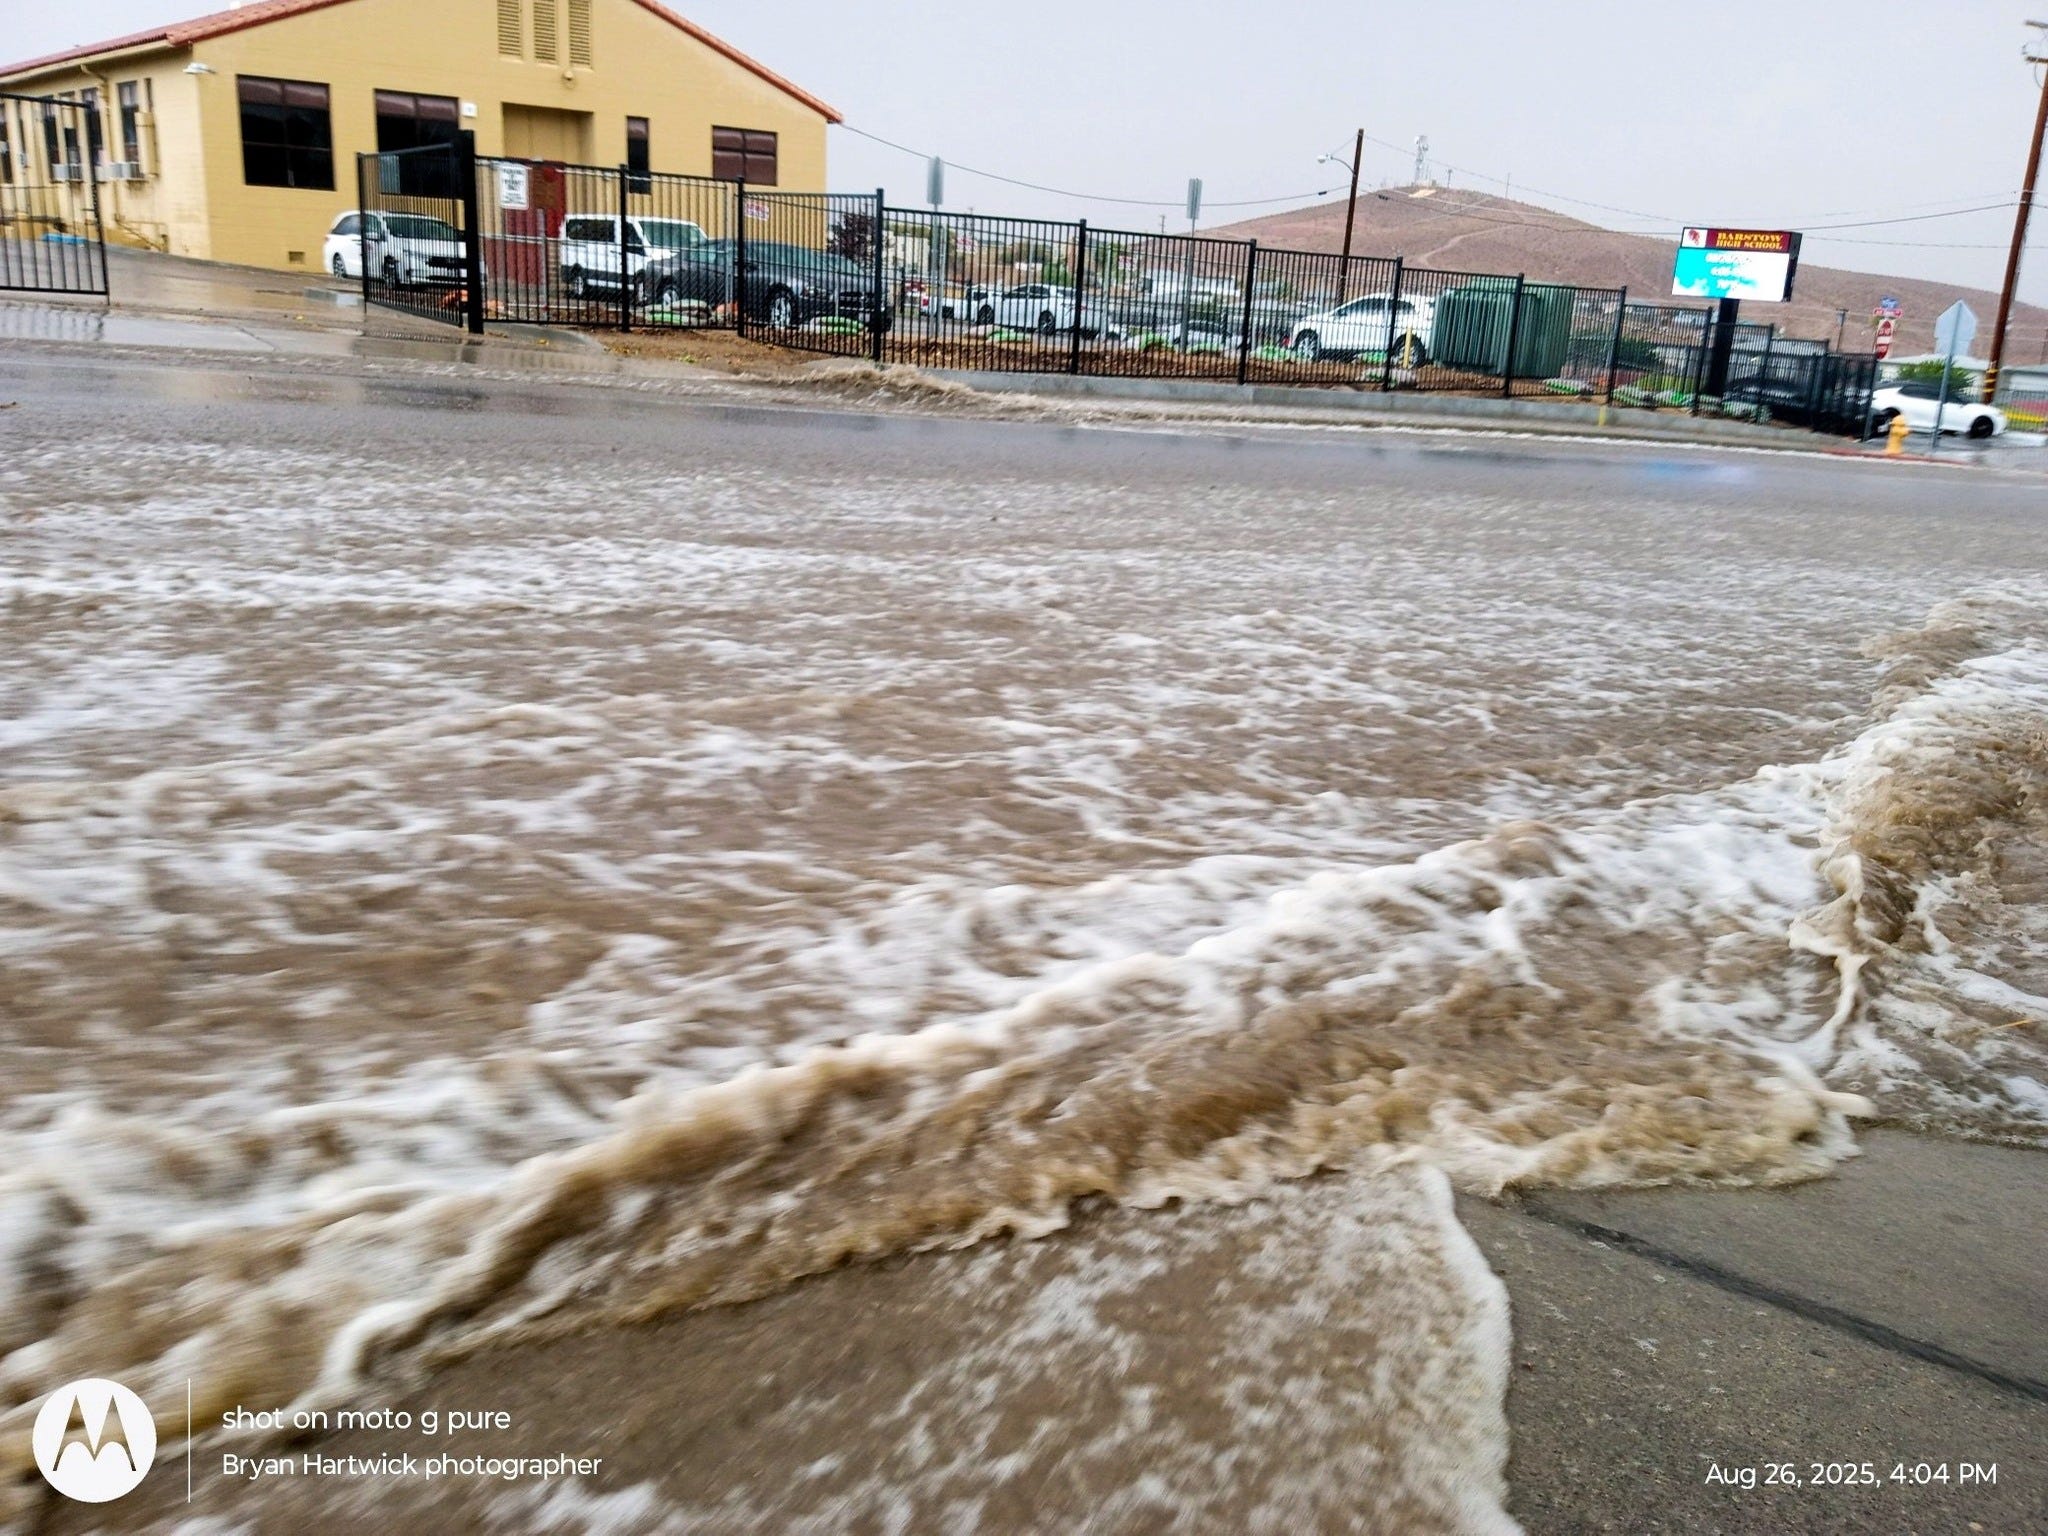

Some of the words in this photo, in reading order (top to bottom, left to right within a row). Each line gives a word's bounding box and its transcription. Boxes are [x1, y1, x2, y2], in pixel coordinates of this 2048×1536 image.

[1717, 232, 1783, 242] BARSTOW
[1715, 239, 1742, 248] HIGH
[1743, 240, 1782, 250] SCHOOL
